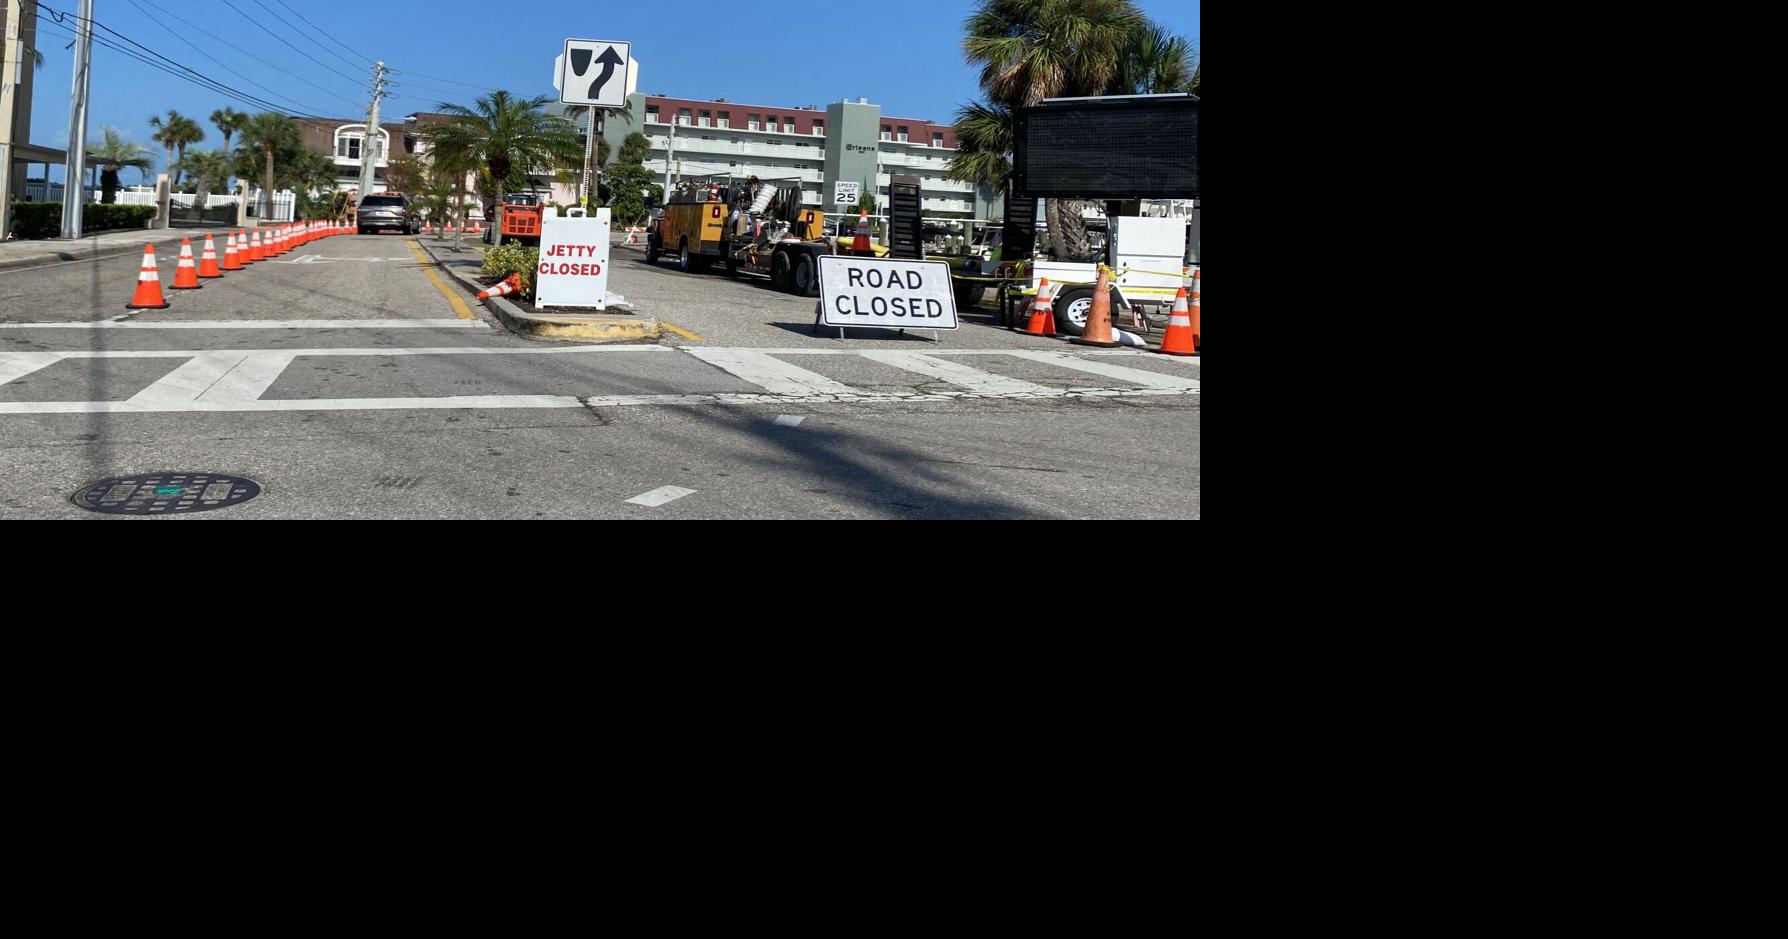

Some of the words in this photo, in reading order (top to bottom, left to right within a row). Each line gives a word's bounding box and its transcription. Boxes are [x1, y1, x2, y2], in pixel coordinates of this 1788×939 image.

[836, 193, 856, 203] 25
[546, 244, 597, 258] JETTY
[539, 262, 601, 276] CLOSED
[847, 267, 923, 290] ROAD
[835, 294, 943, 319] CLOSED
